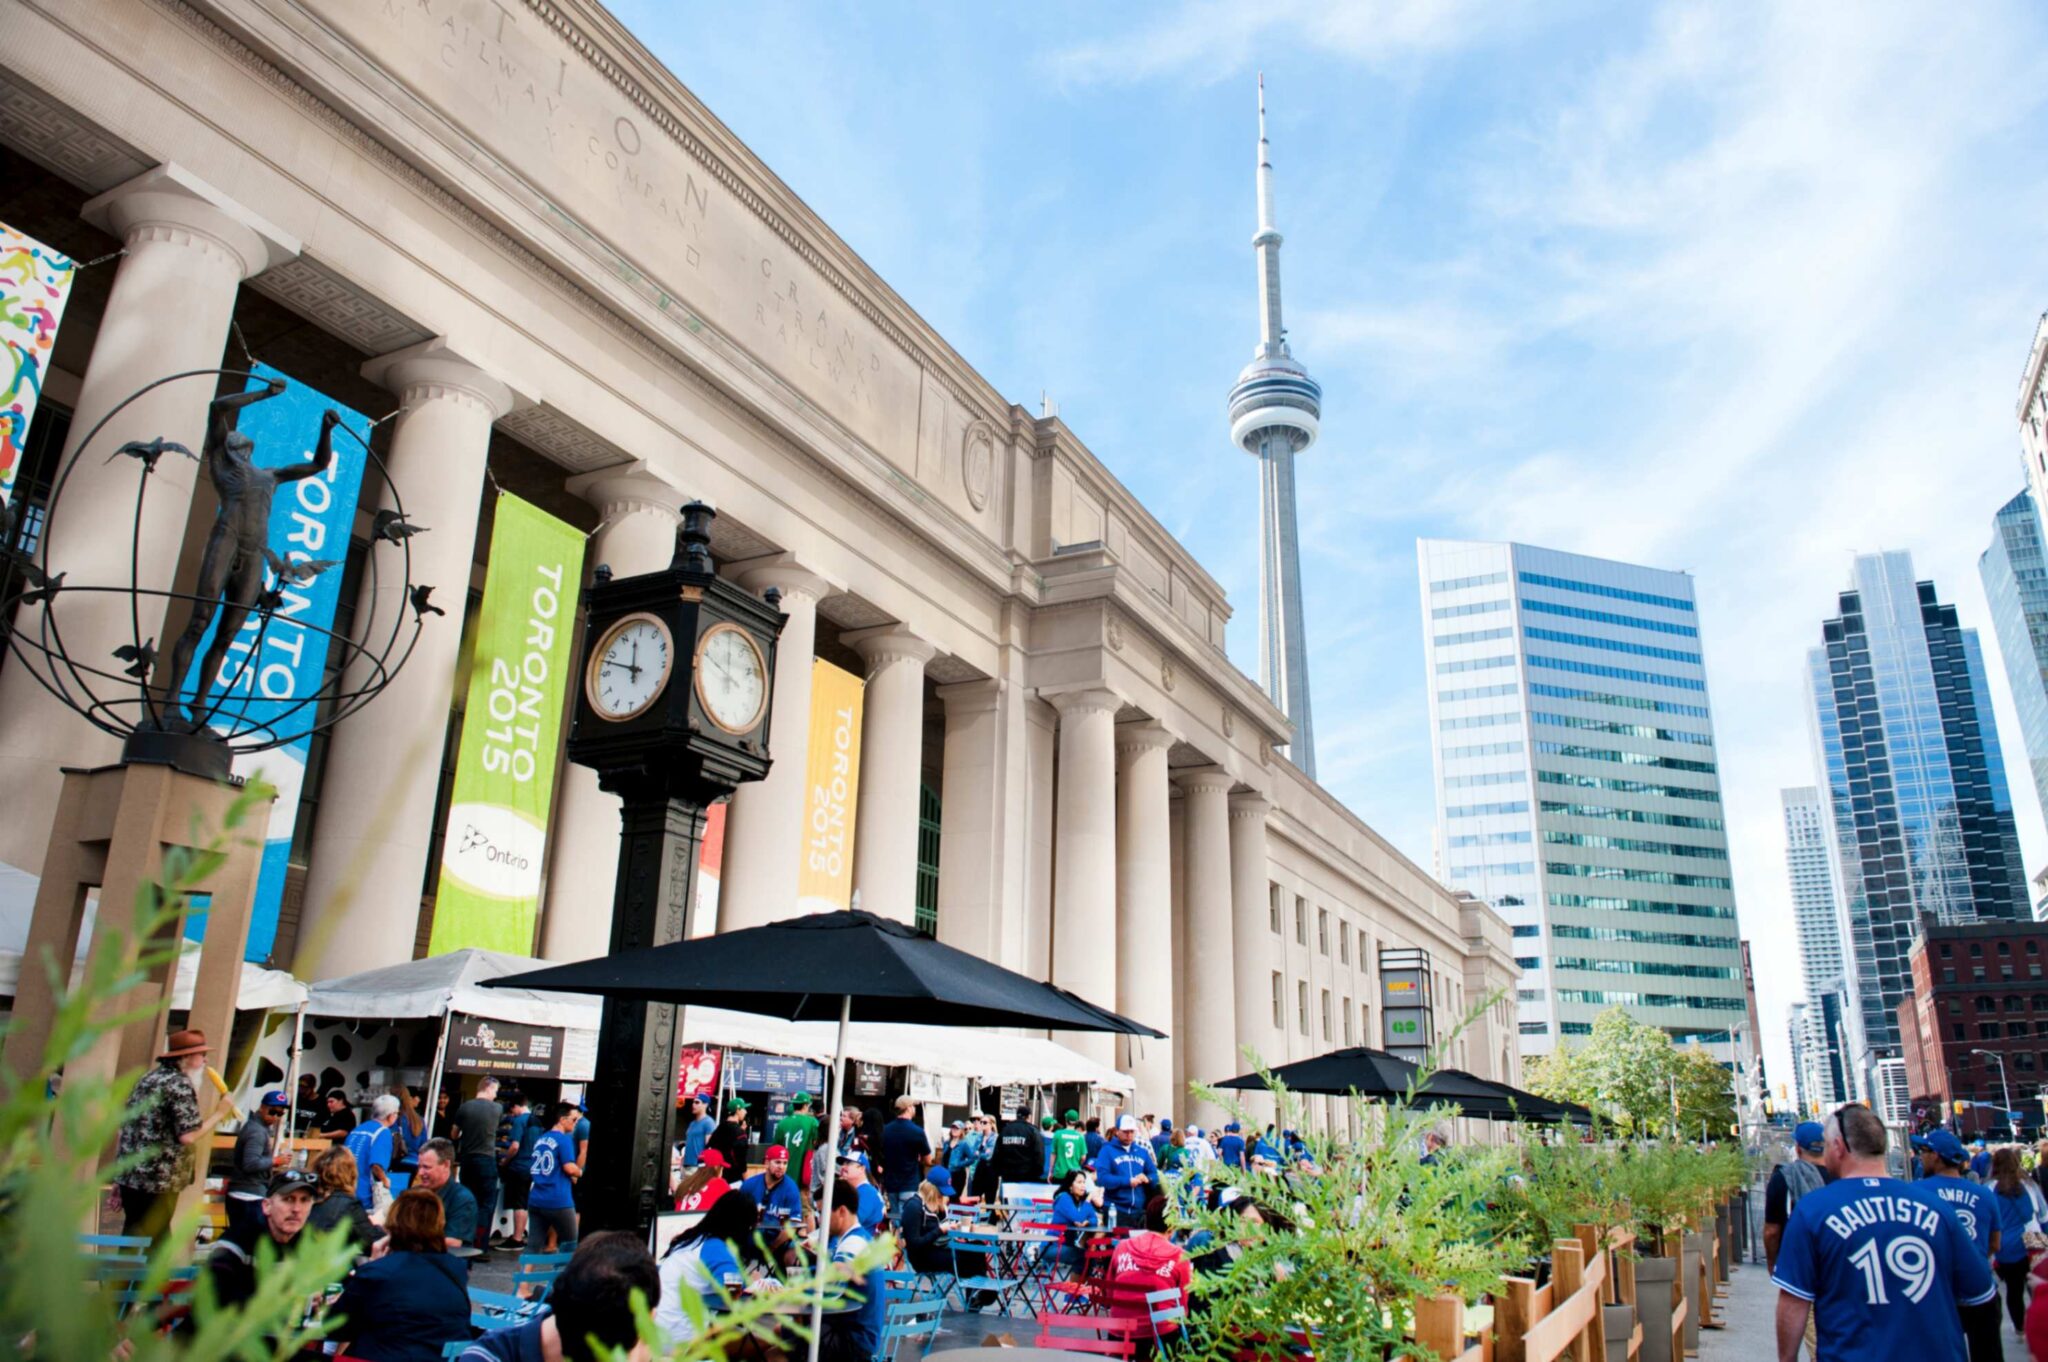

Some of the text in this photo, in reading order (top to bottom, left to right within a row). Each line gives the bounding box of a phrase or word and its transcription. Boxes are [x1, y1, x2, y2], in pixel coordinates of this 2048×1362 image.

[511, 563, 563, 783] TORONTO
[482, 657, 521, 775] 2015
[827, 706, 853, 878] TORONTO
[808, 785, 831, 873] 2015
[784, 1129, 803, 1149] 14
[1002, 1136, 1026, 1145] SECURITY
[1065, 1141, 1075, 1158] 3
[530, 1150, 555, 1176] 20
[680, 1193, 702, 1211] 19
[1825, 1195, 1940, 1240] BAUTISTA
[1847, 1235, 1936, 1305] 19
